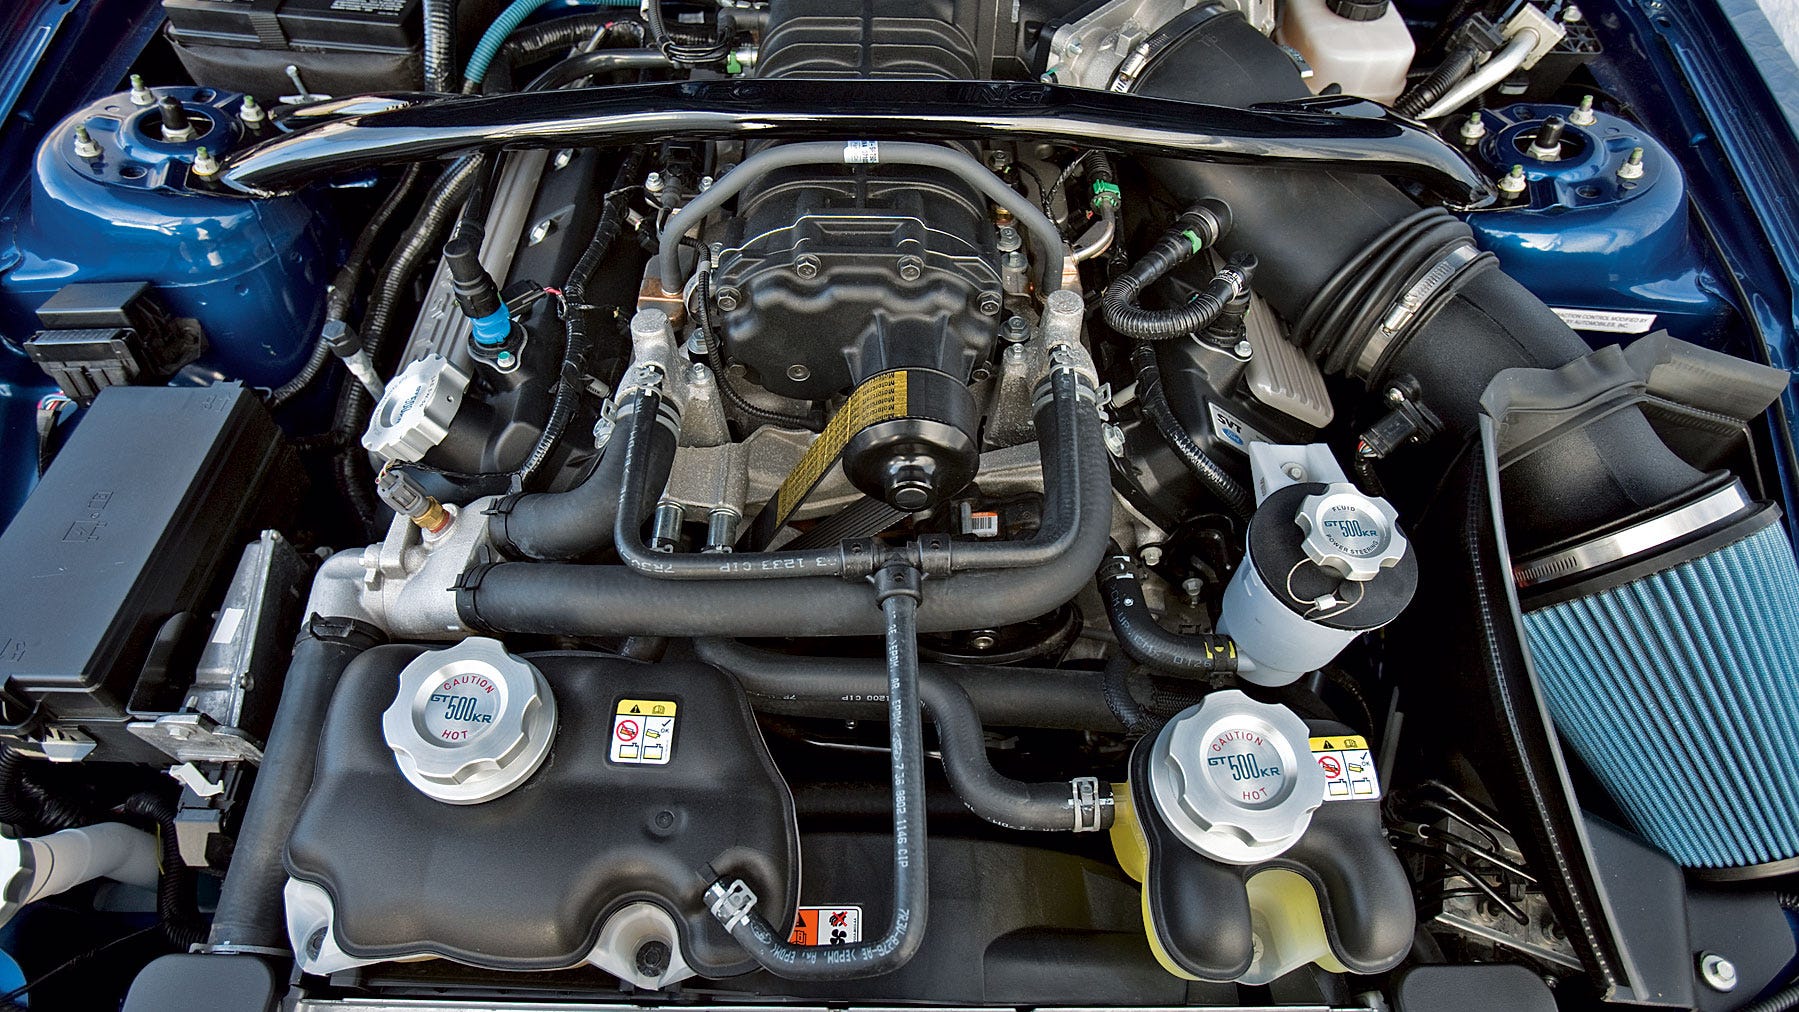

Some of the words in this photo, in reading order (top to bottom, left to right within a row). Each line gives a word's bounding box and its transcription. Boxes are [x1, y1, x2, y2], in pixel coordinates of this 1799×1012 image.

[1217, 414, 1242, 433] SVT
[1324, 520, 1378, 538] GT500KR
[1326, 534, 1348, 552] POWER
[1350, 540, 1379, 554] STEERING
[720, 562, 752, 572] CIP
[762, 558, 804, 570] 1233
[443, 676, 494, 694] CAUTION
[430, 694, 492, 723] GT500KR
[442, 730, 468, 740] HOT
[1212, 731, 1264, 752] CAUTION
[1208, 753, 1280, 780] GT500KR
[1242, 787, 1268, 800] HOT
[896, 820, 908, 845] 1146
[898, 849, 908, 868] CIP
